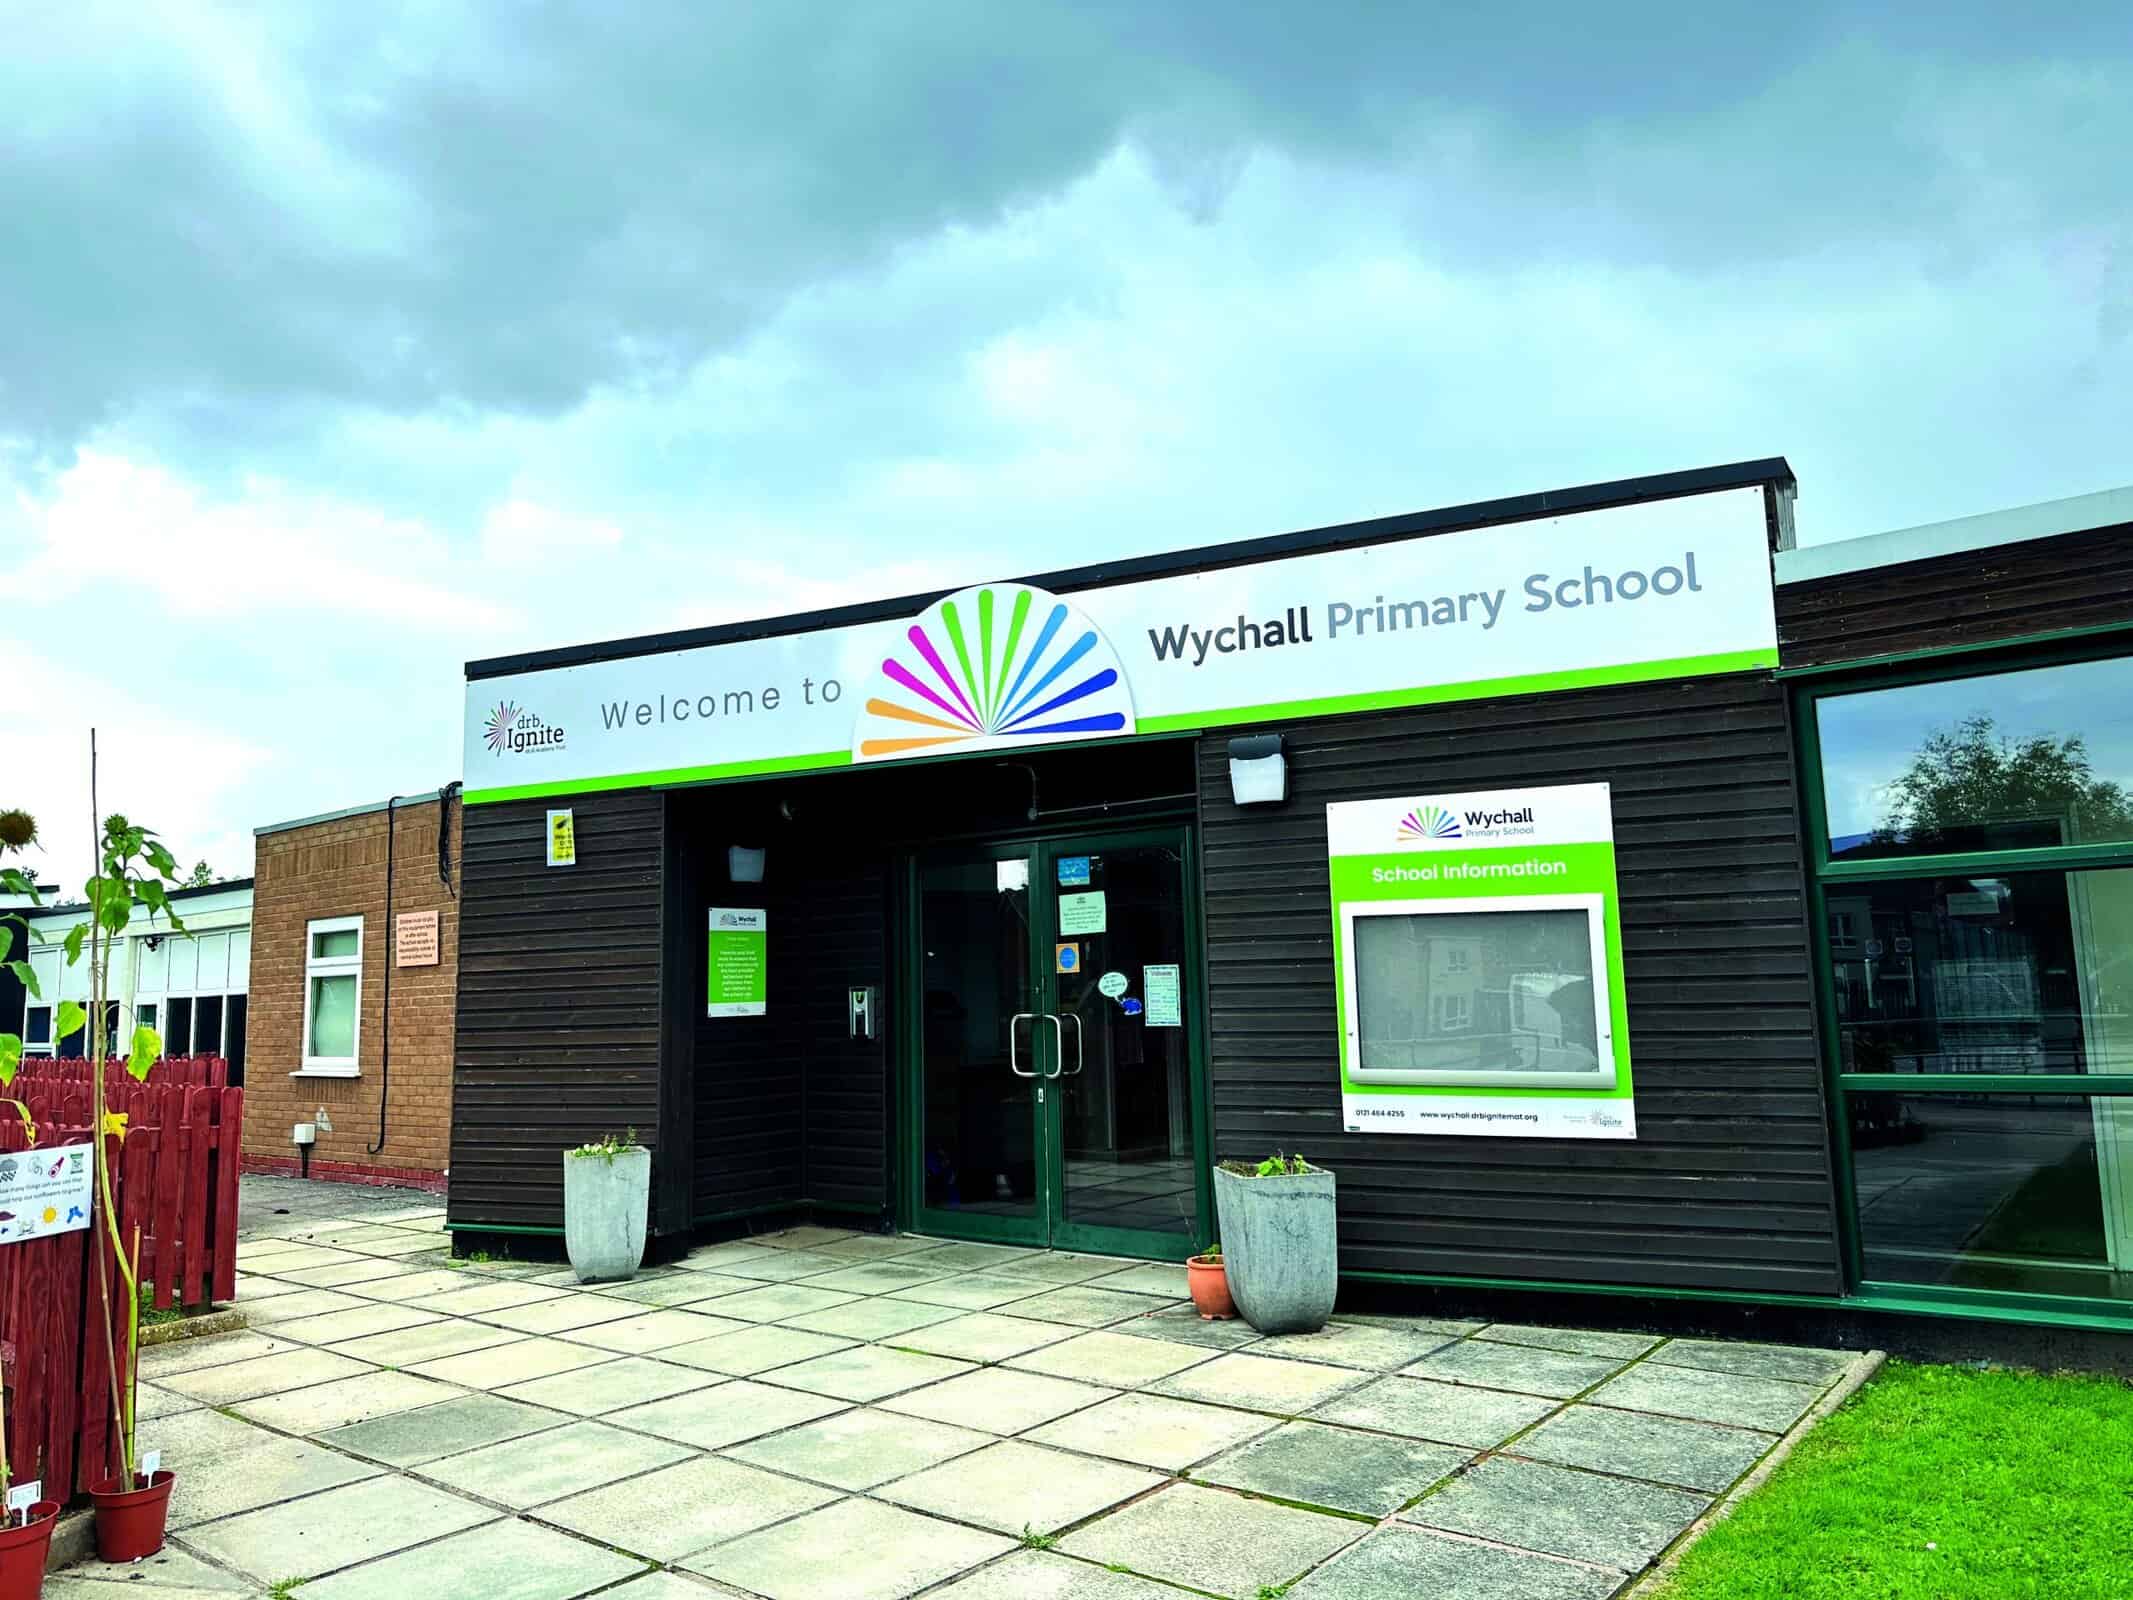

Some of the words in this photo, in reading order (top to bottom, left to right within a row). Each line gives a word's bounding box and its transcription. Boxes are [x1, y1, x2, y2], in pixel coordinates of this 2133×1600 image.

[1148, 606, 1312, 666] Wychall
[1327, 588, 1506, 638] Primary
[1523, 551, 1702, 612] School
[601, 685, 780, 730] Welcome
[803, 678, 841, 705] to
[517, 713, 540, 729] drb
[507, 724, 564, 753] Ignite
[1464, 807, 1534, 829] Wychall
[1465, 828, 1500, 838] Primary
[1503, 826, 1534, 836] School
[1372, 864, 1438, 883] School
[1444, 858, 1567, 880] Information
[1355, 1109, 1370, 1117] 0121
